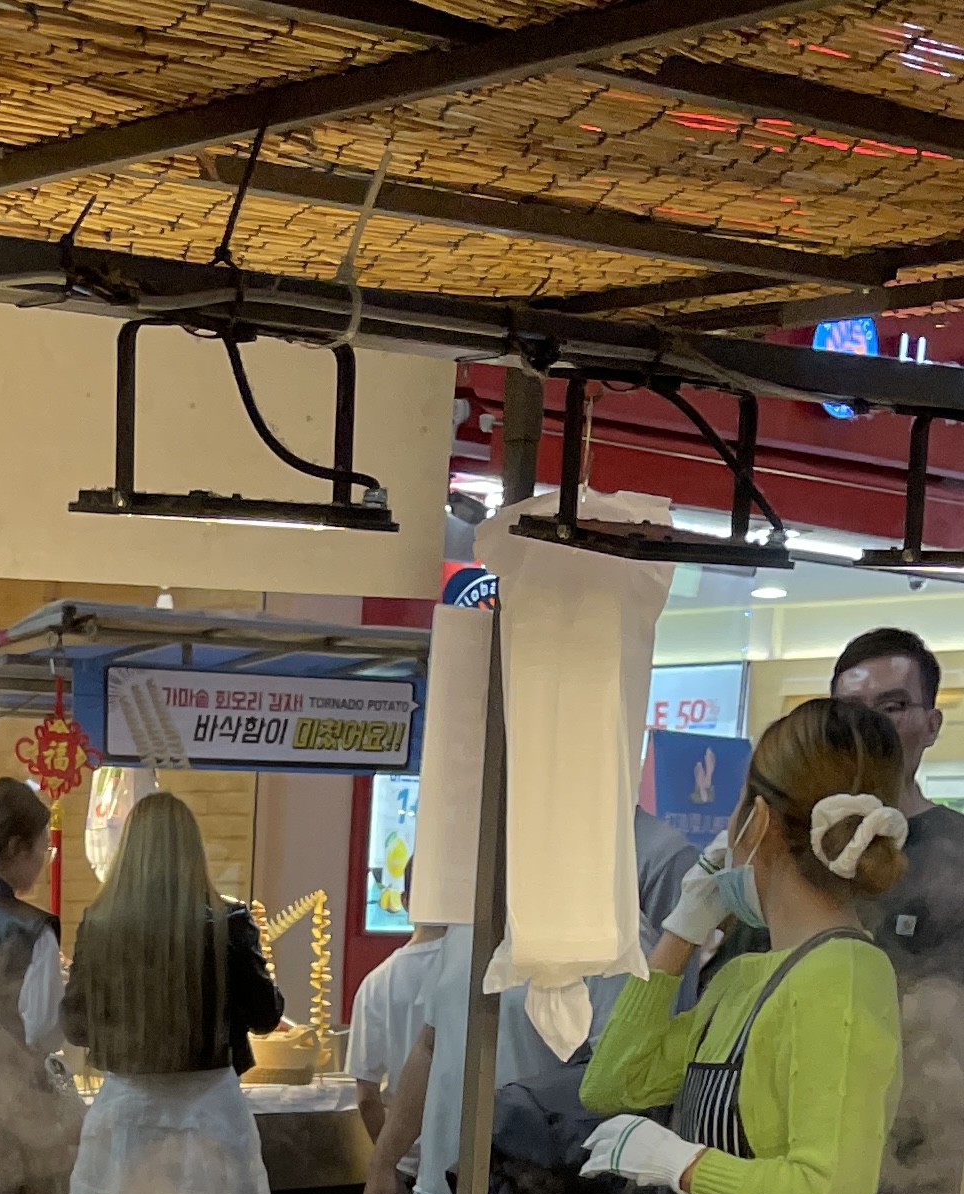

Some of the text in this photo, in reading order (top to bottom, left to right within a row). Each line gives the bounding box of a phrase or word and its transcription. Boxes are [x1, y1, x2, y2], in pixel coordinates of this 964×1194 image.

[458, 581, 496, 607] loba
[215, 690, 262, 711] 회오리
[309, 696, 410, 713] TORNADO POTATO
[193, 714, 289, 744] 바삭함이
[42, 740, 70, 771] 福
